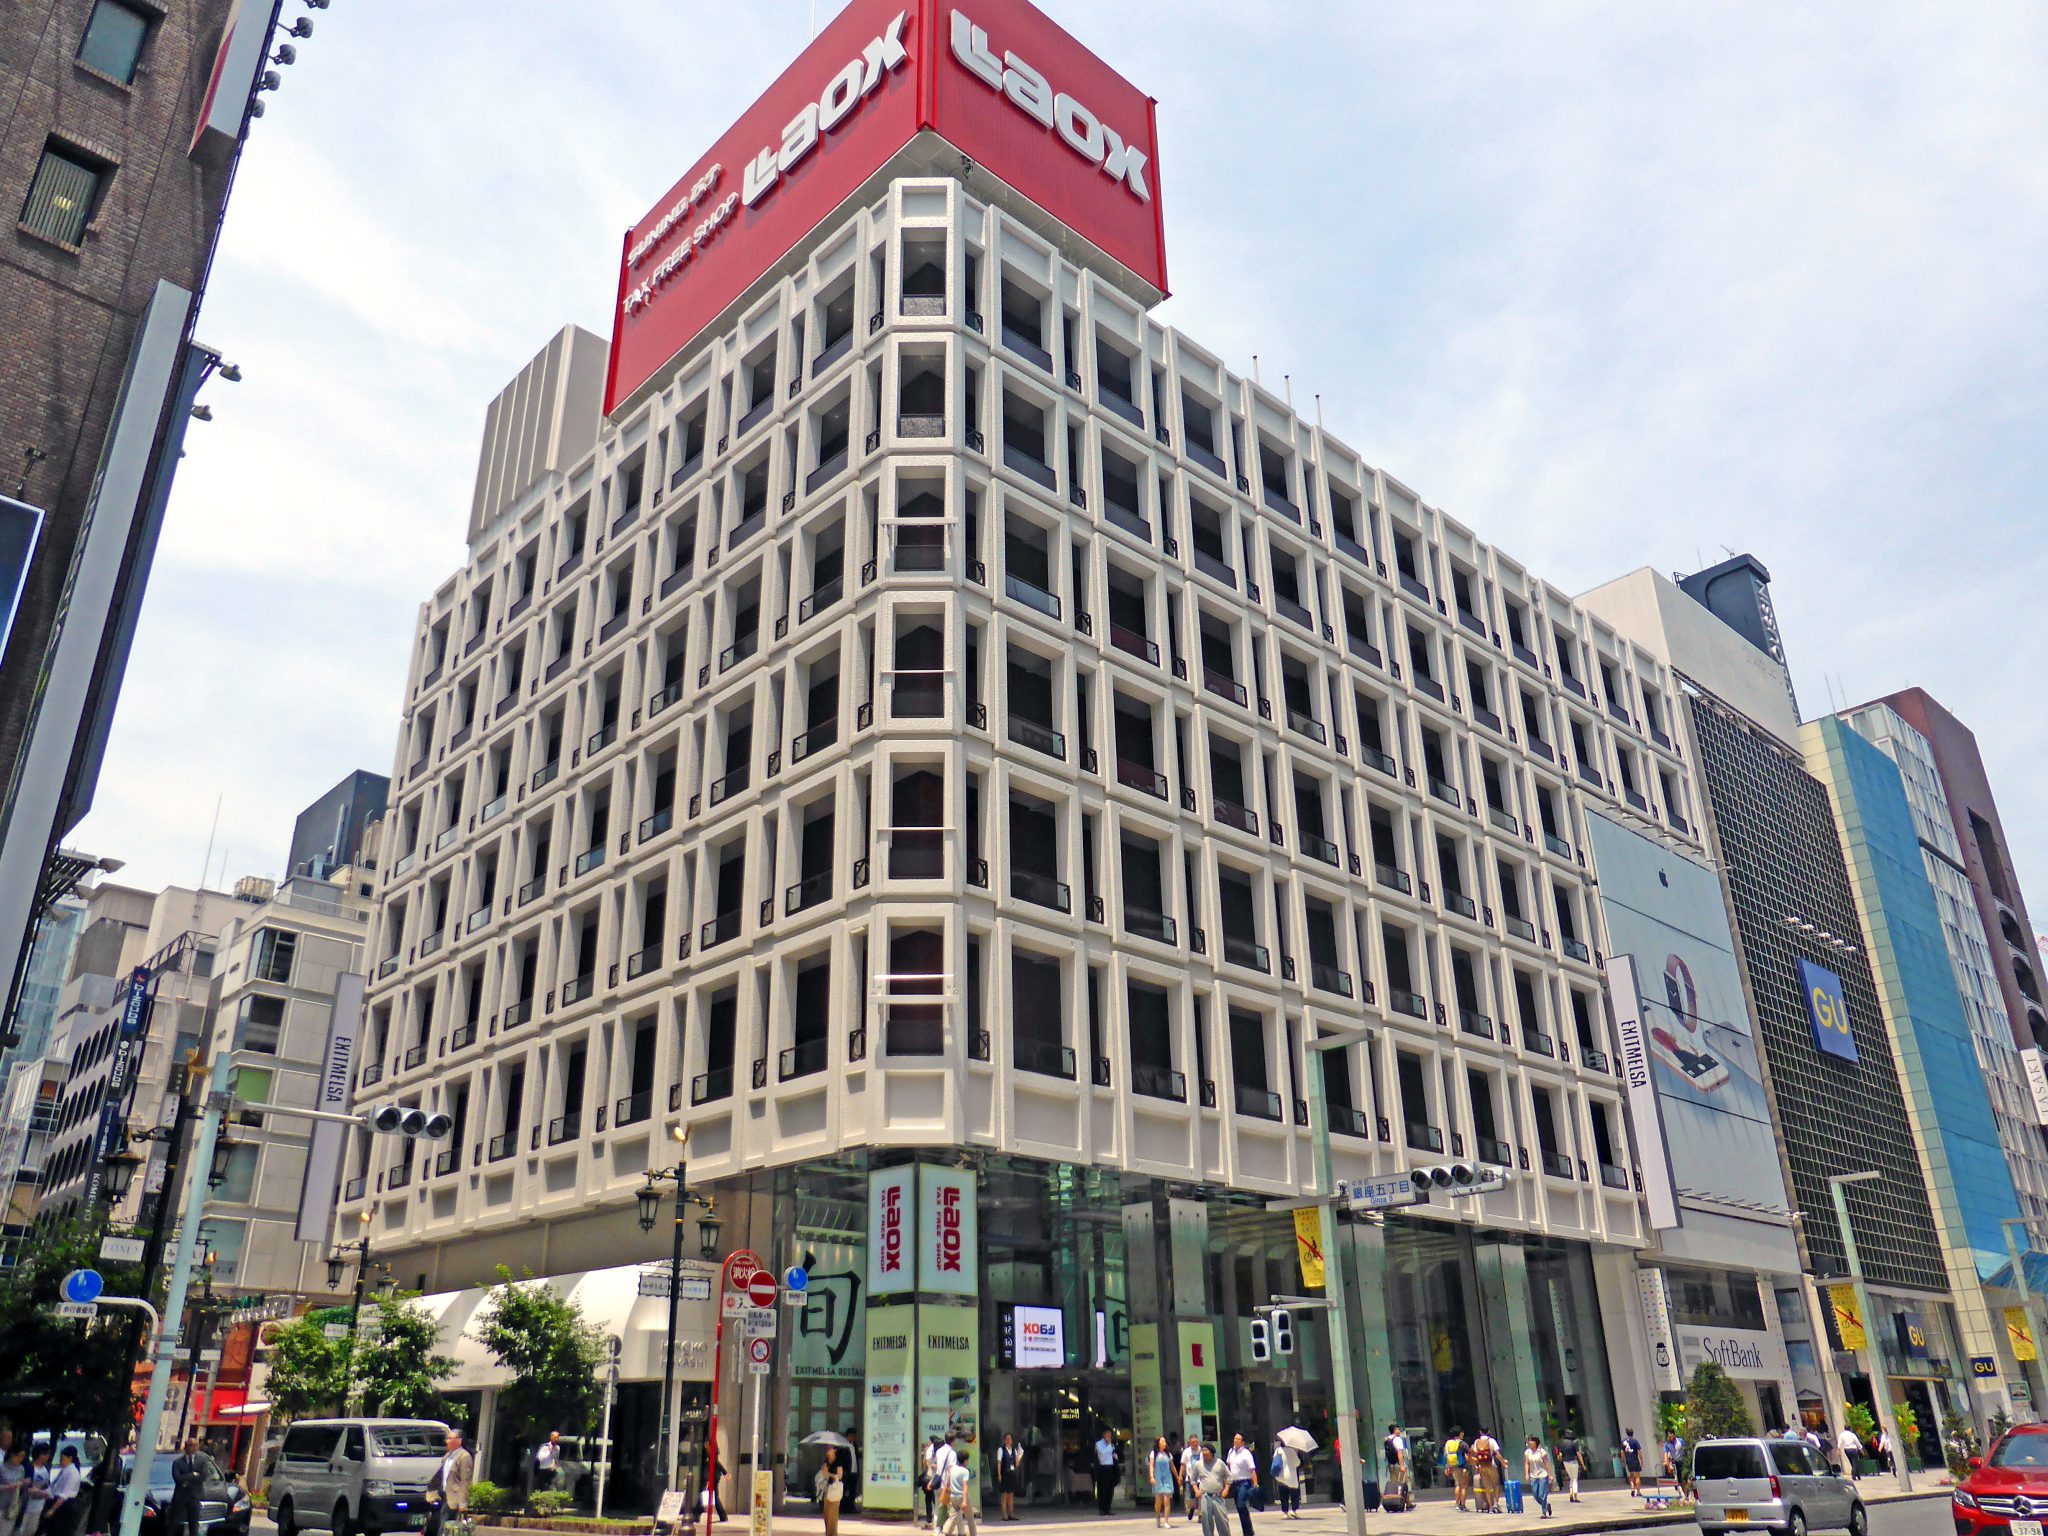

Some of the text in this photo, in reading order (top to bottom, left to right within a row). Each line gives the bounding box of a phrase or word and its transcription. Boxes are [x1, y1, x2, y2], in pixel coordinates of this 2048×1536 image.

[627, 196, 690, 268] SUNING
[623, 191, 740, 315] TAX FREE SHOP
[1812, 986, 1848, 1036] GU
[1621, 1019, 1647, 1089] EXITMELSA
[326, 1036, 352, 1102] EXITMELSA
[1353, 1181, 1409, 1199] 銀座五丁目
[1370, 1196, 1387, 1205] Ginza
[872, 1334, 907, 1351] EXITMELSA
[928, 1334, 970, 1350] EXITMELSA
[1908, 1325, 1926, 1347] GU
[1703, 1337, 1764, 1368] SoftBank
[795, 1365, 836, 1376] EXITMELSA
[1974, 1362, 1994, 1373] GU
